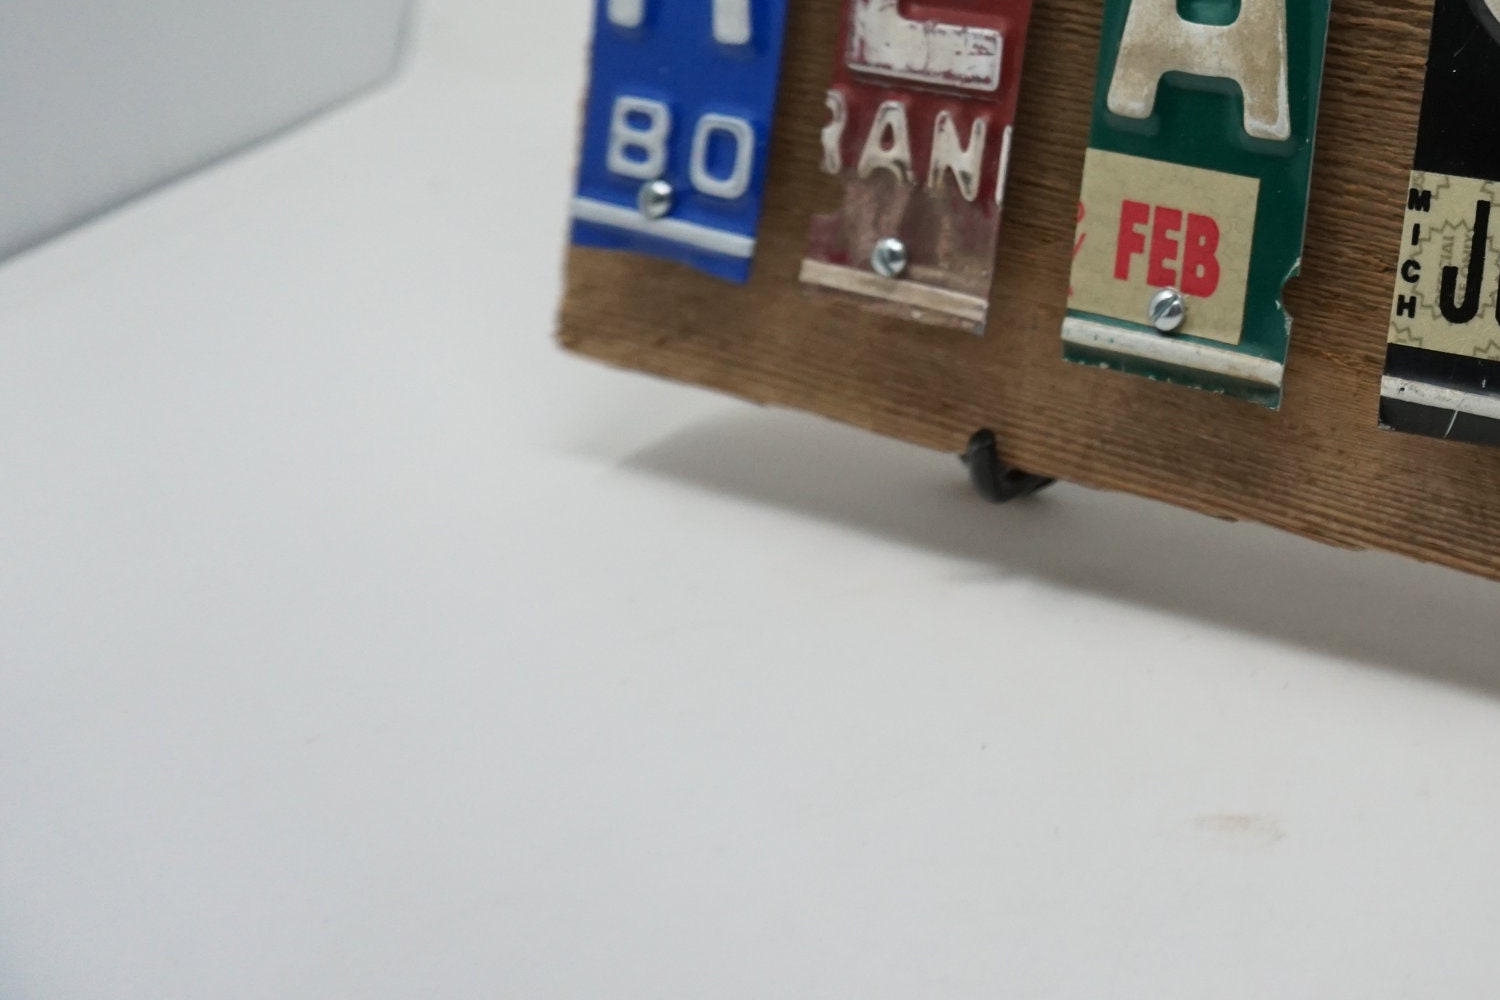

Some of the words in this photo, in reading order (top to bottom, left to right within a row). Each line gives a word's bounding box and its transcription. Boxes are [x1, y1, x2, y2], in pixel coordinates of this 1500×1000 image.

[606, 95, 755, 200] 80
[1113, 199, 1221, 298] FEB
[1396, 188, 1432, 319] MICH
